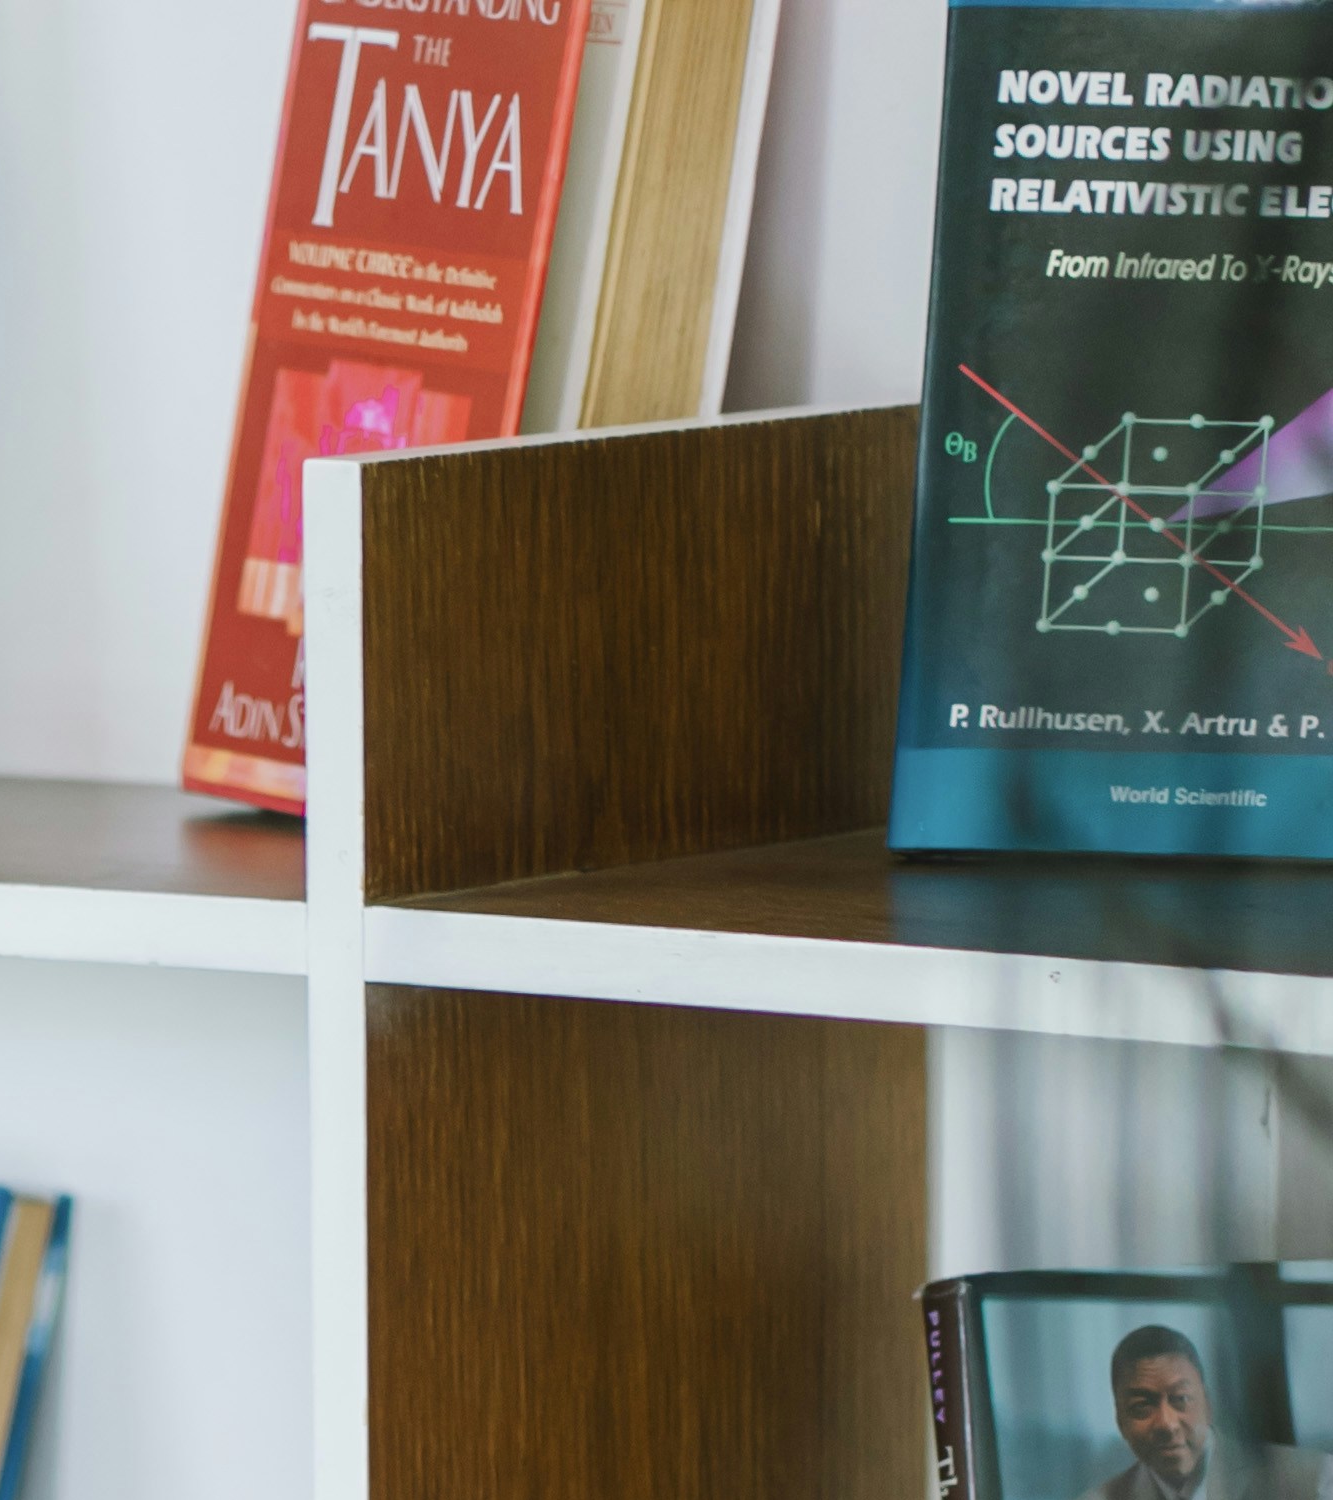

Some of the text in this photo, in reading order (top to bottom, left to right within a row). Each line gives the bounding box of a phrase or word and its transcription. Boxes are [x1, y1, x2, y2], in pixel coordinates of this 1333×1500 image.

[413, 34, 453, 67] THE
[998, 69, 1333, 110] NOVEL RADIATIO
[308, 22, 523, 227] TANYA
[994, 123, 1303, 164] SOURCES USING
[989, 177, 1333, 219] RELATIVISTIC ELE
[1045, 249, 1333, 290] From Infrared To X-Ray
[208, 679, 286, 743] ADIN
[949, 703, 1326, 740] P. Rullhusen, X. Artru & P.
[1110, 785, 1268, 808] World Scientific
